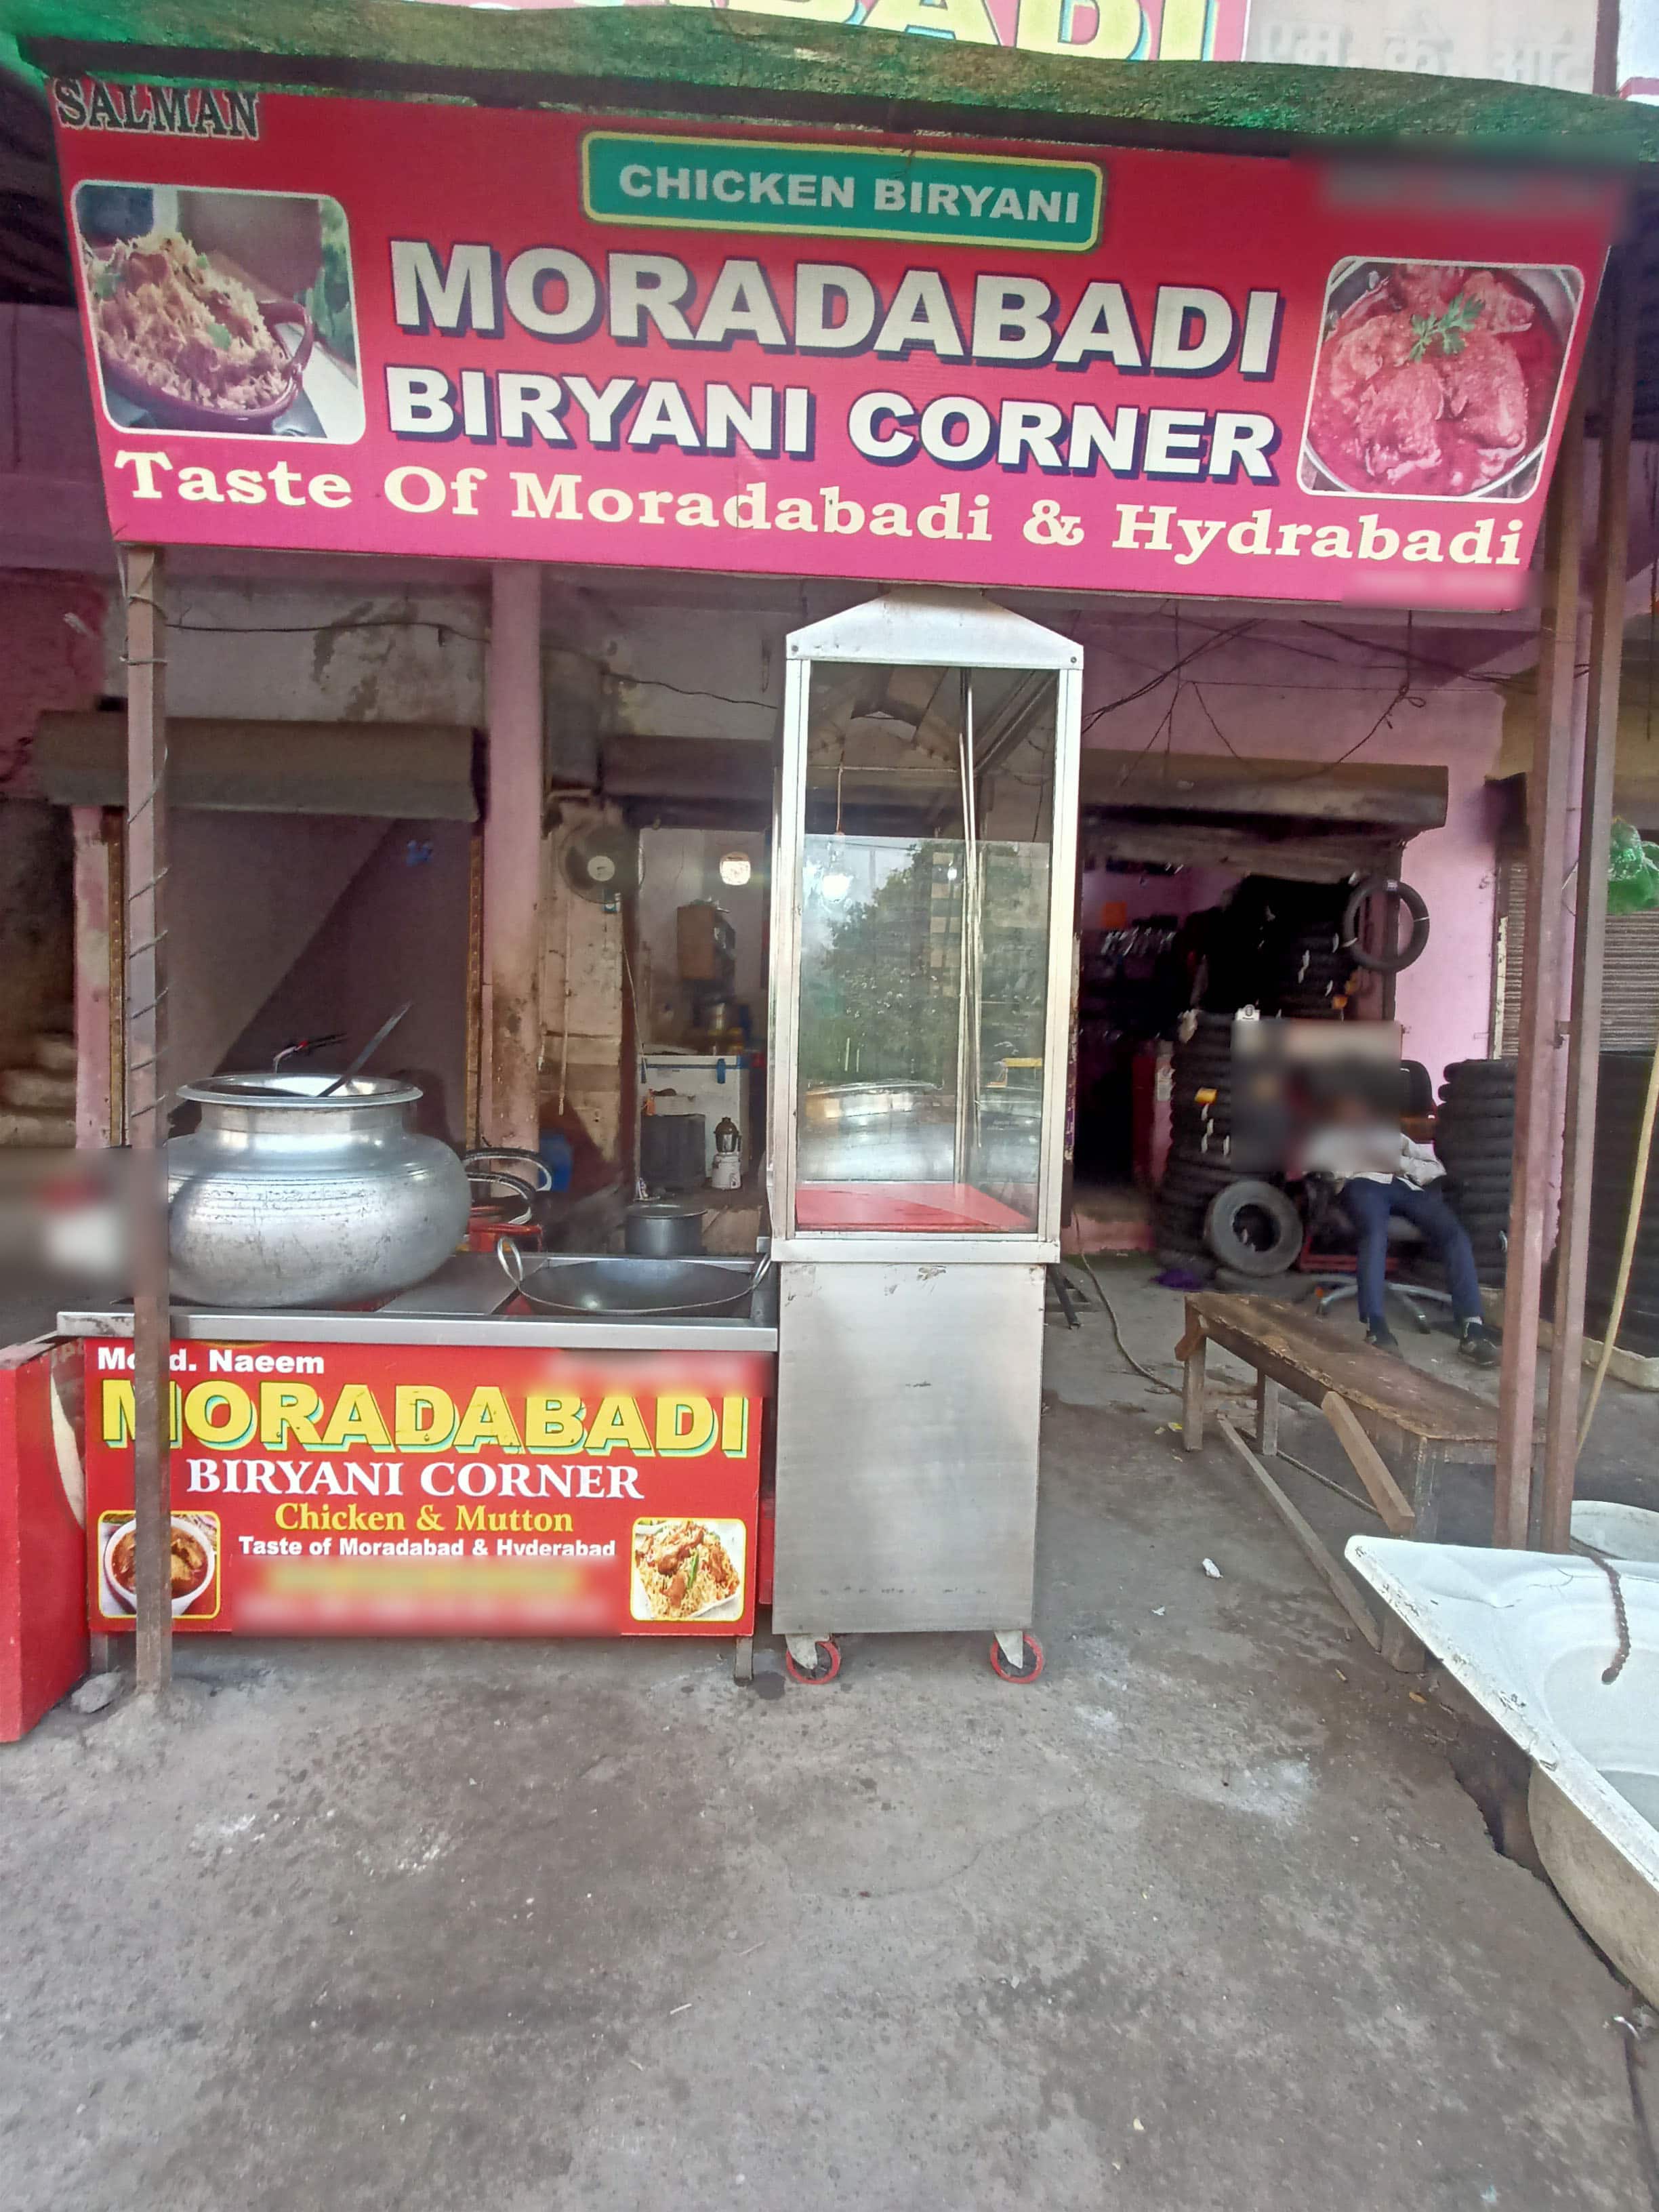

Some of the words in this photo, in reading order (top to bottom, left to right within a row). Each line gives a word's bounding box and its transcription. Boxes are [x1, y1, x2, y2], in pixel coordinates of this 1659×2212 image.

[53, 77, 259, 141] SALMAN
[619, 165, 855, 210] CHICKEN
[874, 179, 1080, 224] BIRYANI
[390, 240, 1284, 380] MORADABADI
[386, 366, 815, 458] BIRYANI
[848, 390, 1280, 486] CORNER
[115, 451, 352, 506] Taste
[384, 466, 487, 516] Of
[510, 472, 993, 542] Moradabadi
[1022, 498, 1085, 547] &
[1111, 504, 1522, 565] Hydrabadi
[97, 1346, 197, 1372] Md.
[209, 1349, 324, 1374] Naeem
[186, 1458, 403, 1496] BIRYANI
[420, 1462, 644, 1499] CORNER
[239, 1536, 302, 1555] Taste
[309, 1537, 331, 1556] of
[340, 1537, 464, 1557] Moradabad
[472, 1538, 488, 1557] &
[274, 1502, 405, 1532] Chicken
[416, 1504, 445, 1532] &
[455, 1504, 573, 1533] Mutton
